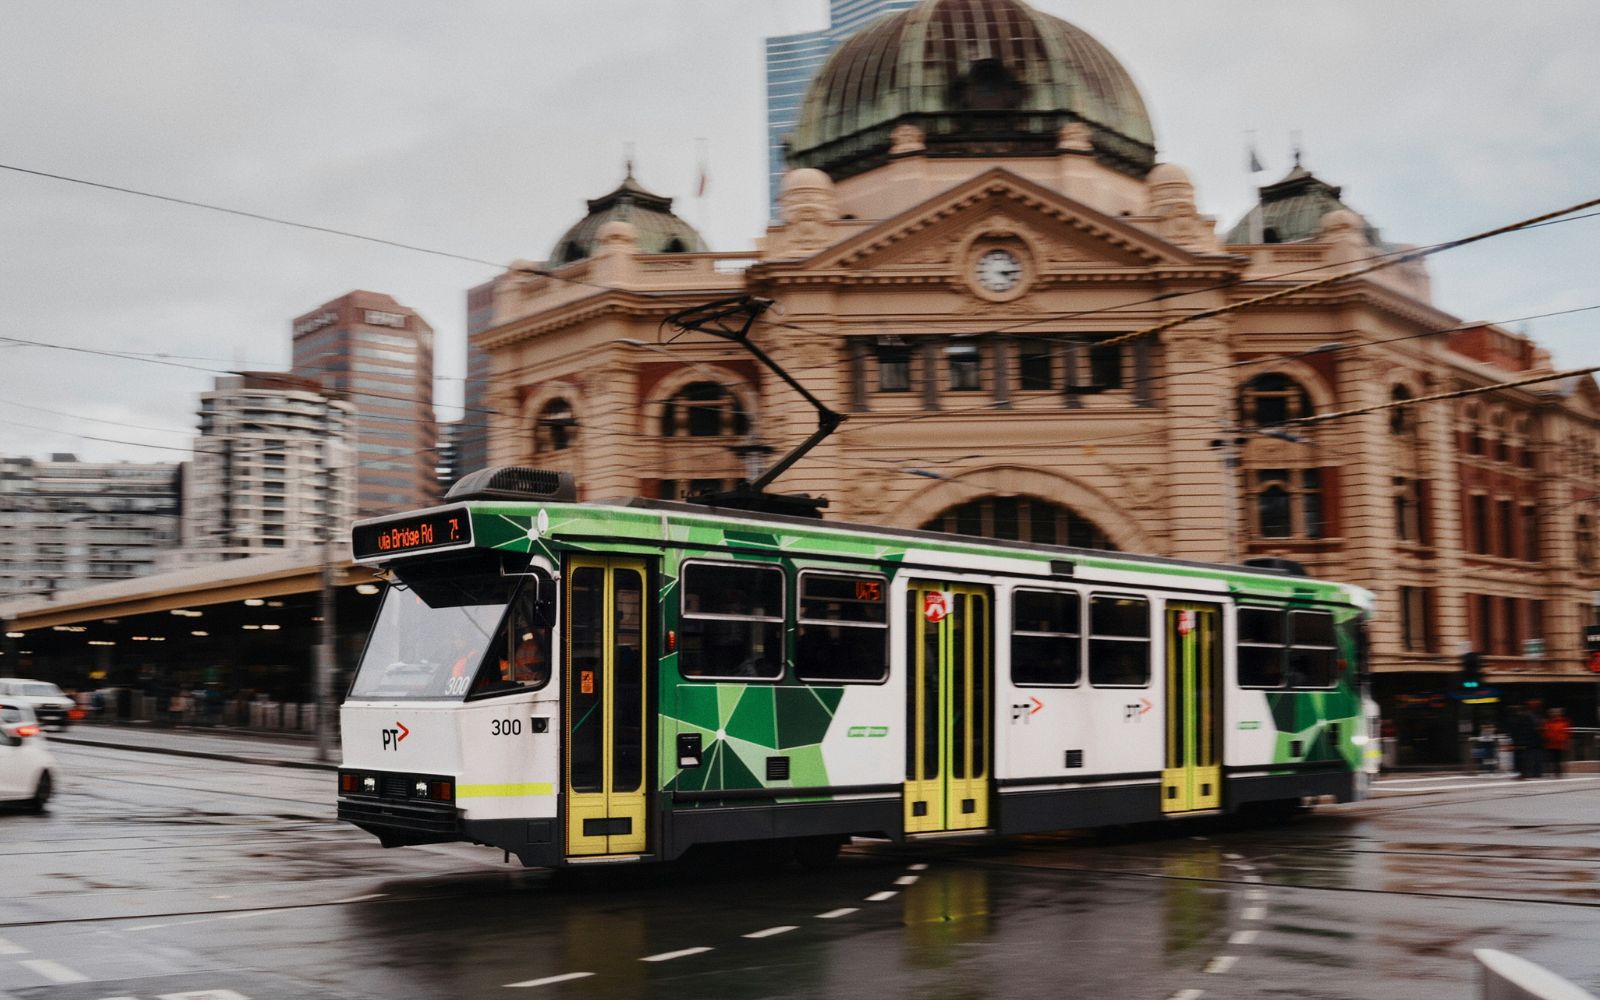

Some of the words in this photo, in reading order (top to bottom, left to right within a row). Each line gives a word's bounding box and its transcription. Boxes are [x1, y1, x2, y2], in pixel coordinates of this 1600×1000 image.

[378, 532, 391, 550] via
[392, 528, 420, 548] Bridge
[421, 523, 433, 544] Rd
[444, 676, 471, 696] 300
[491, 719, 522, 736] 300
